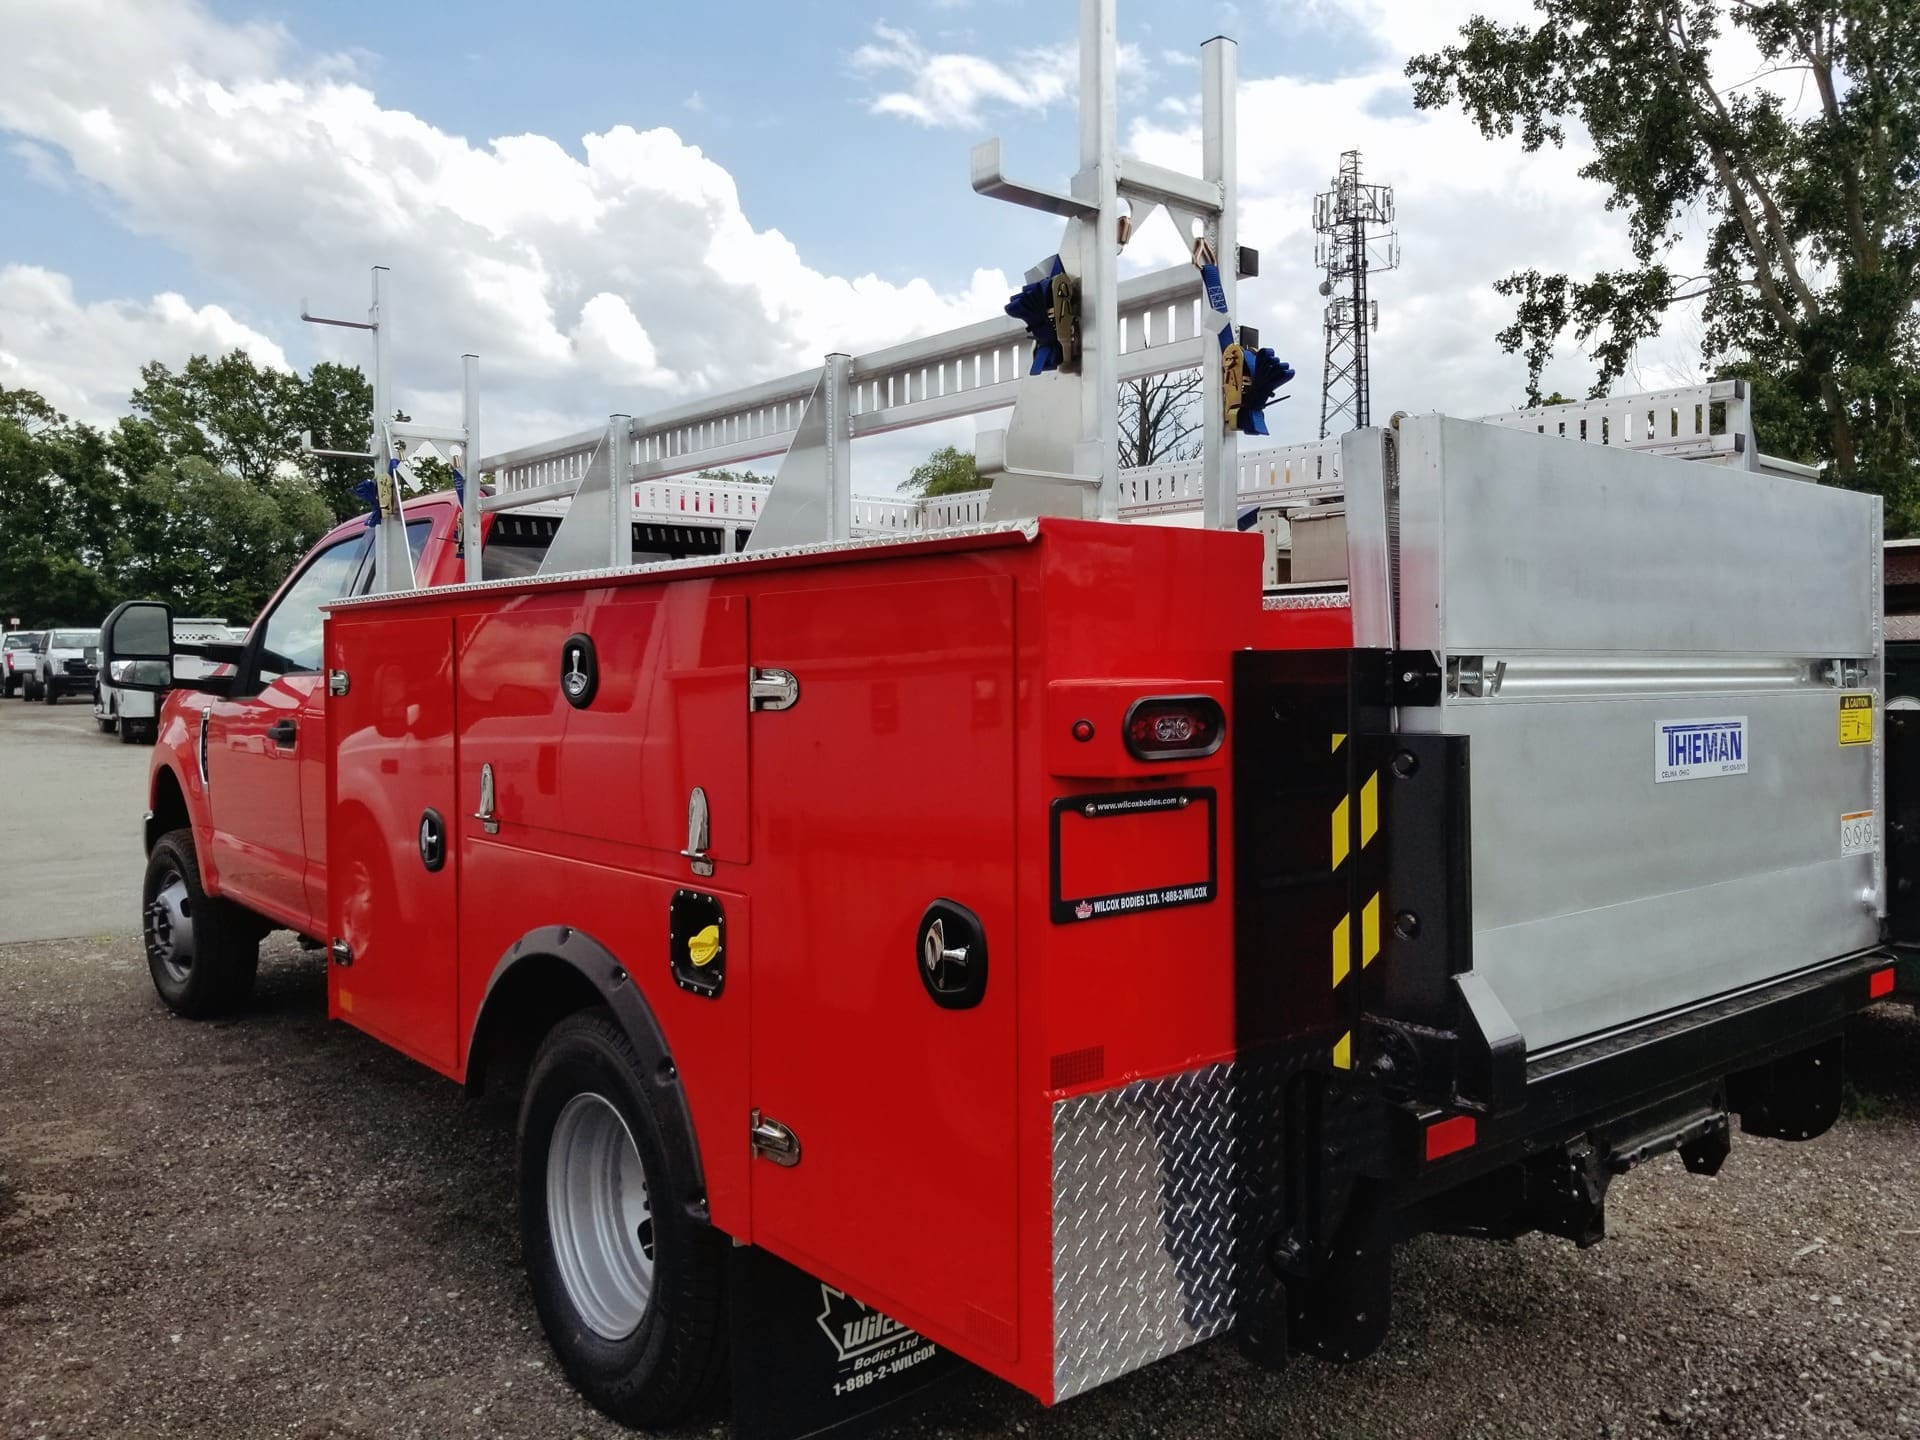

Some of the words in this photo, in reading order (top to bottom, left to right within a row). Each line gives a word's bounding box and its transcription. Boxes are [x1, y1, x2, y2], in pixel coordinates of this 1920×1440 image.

[1850, 698, 1868, 707] CAUTION
[1662, 722, 1742, 766] THIEMAN
[1097, 798, 1177, 810] www.wilcoxbodies.com
[1093, 900, 1120, 912] WILCOX
[1120, 895, 1145, 909] BODIES
[1145, 893, 1160, 905] LTD.
[1160, 886, 1208, 903] 1-888-2-WILCOX
[832, 1343, 936, 1396] 1-888-2-WILCOX
[853, 1346, 897, 1371] Bodies
